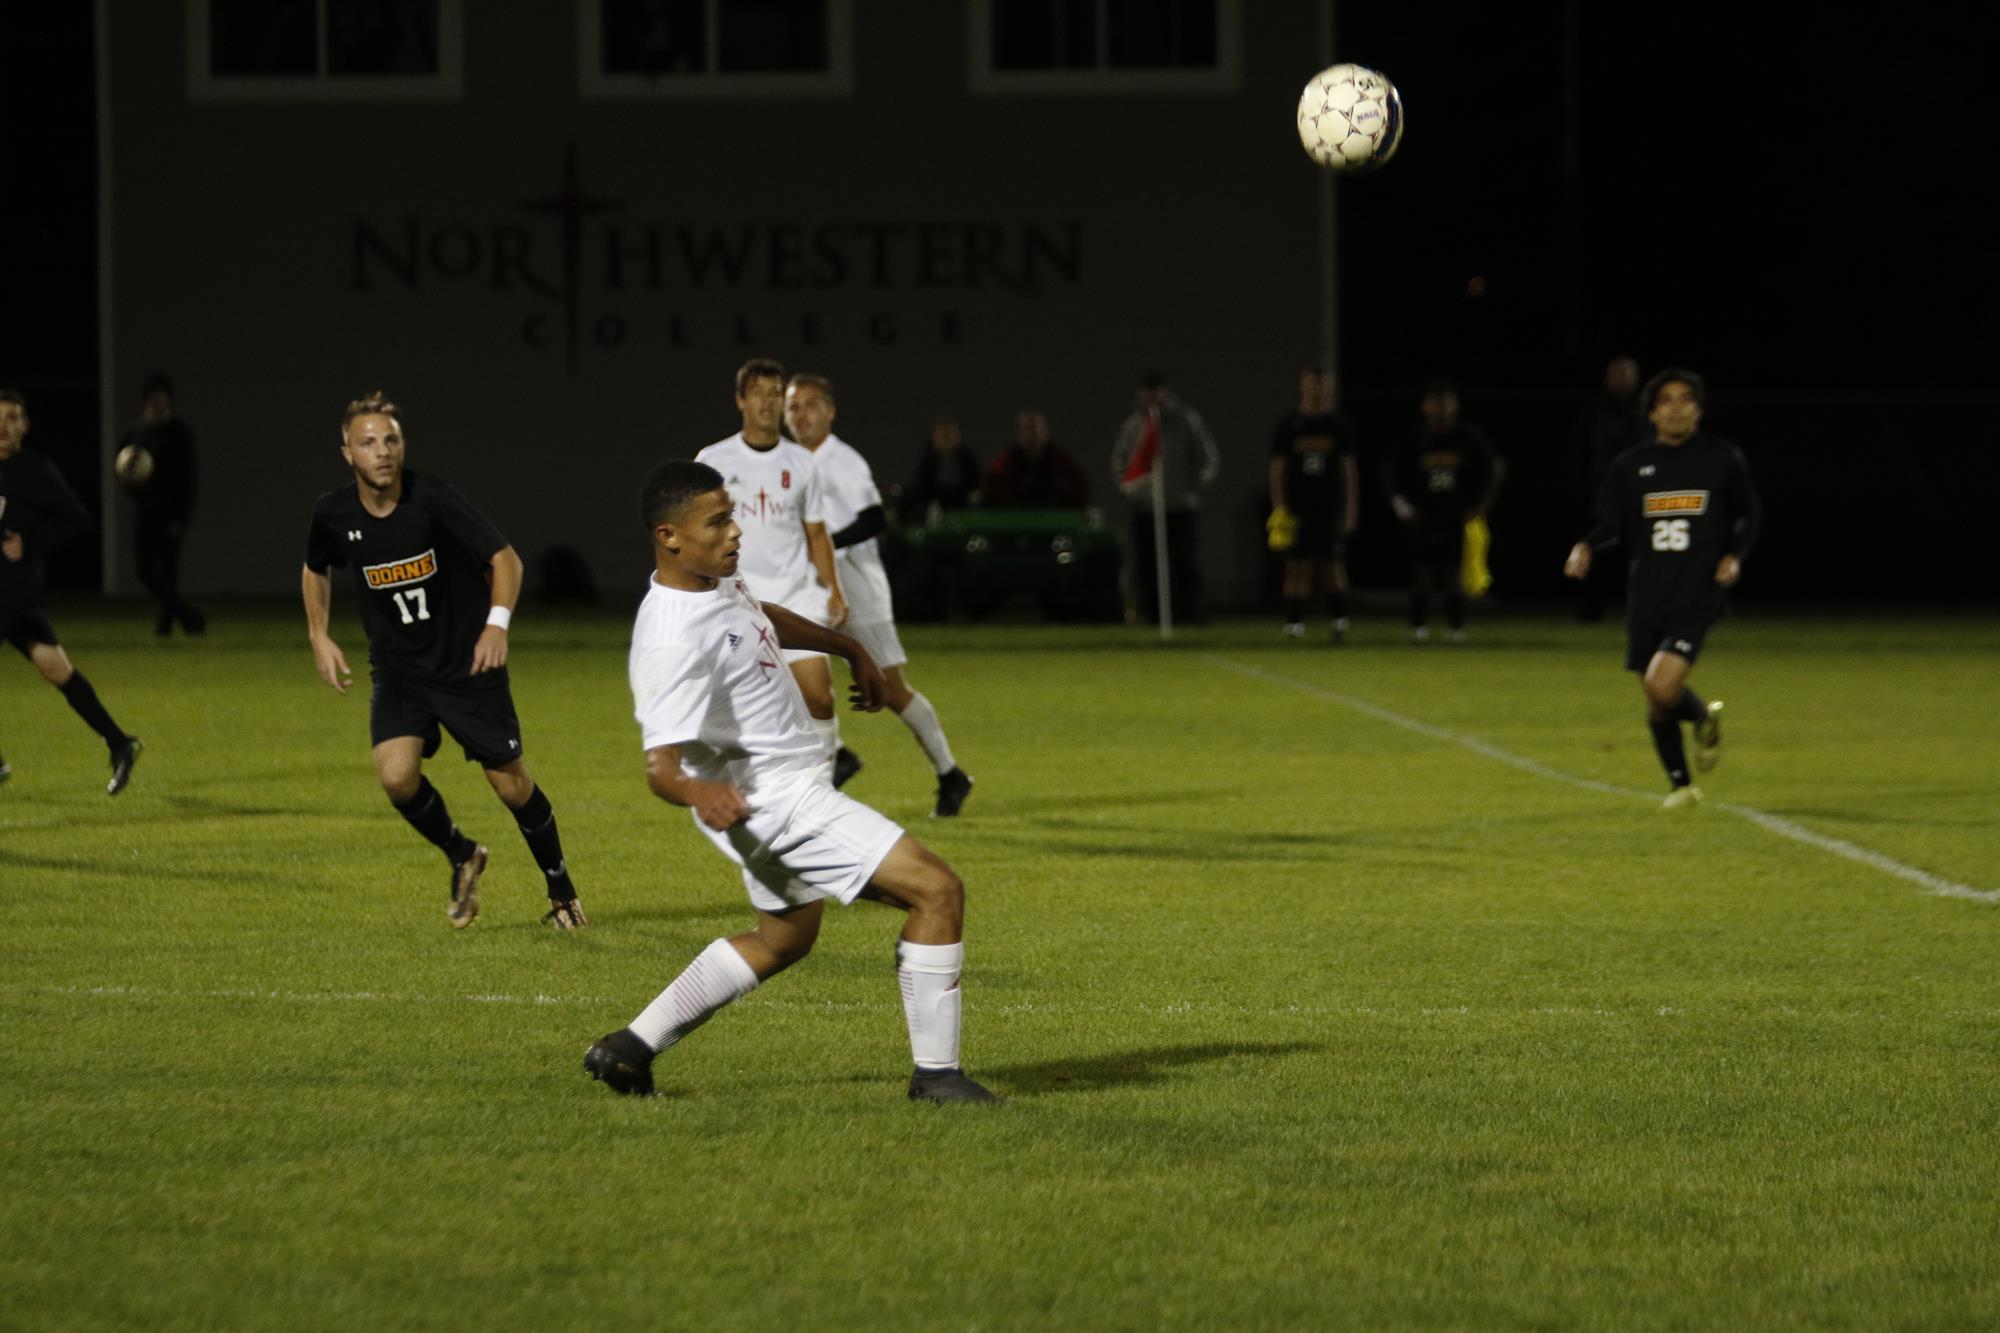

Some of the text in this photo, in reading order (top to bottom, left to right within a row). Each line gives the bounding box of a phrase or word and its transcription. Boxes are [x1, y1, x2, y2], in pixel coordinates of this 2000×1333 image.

[522, 312, 965, 346] COLLEGE
[1651, 519, 1691, 551] 26
[366, 552, 434, 587] DOANE
[393, 587, 431, 624] 17
